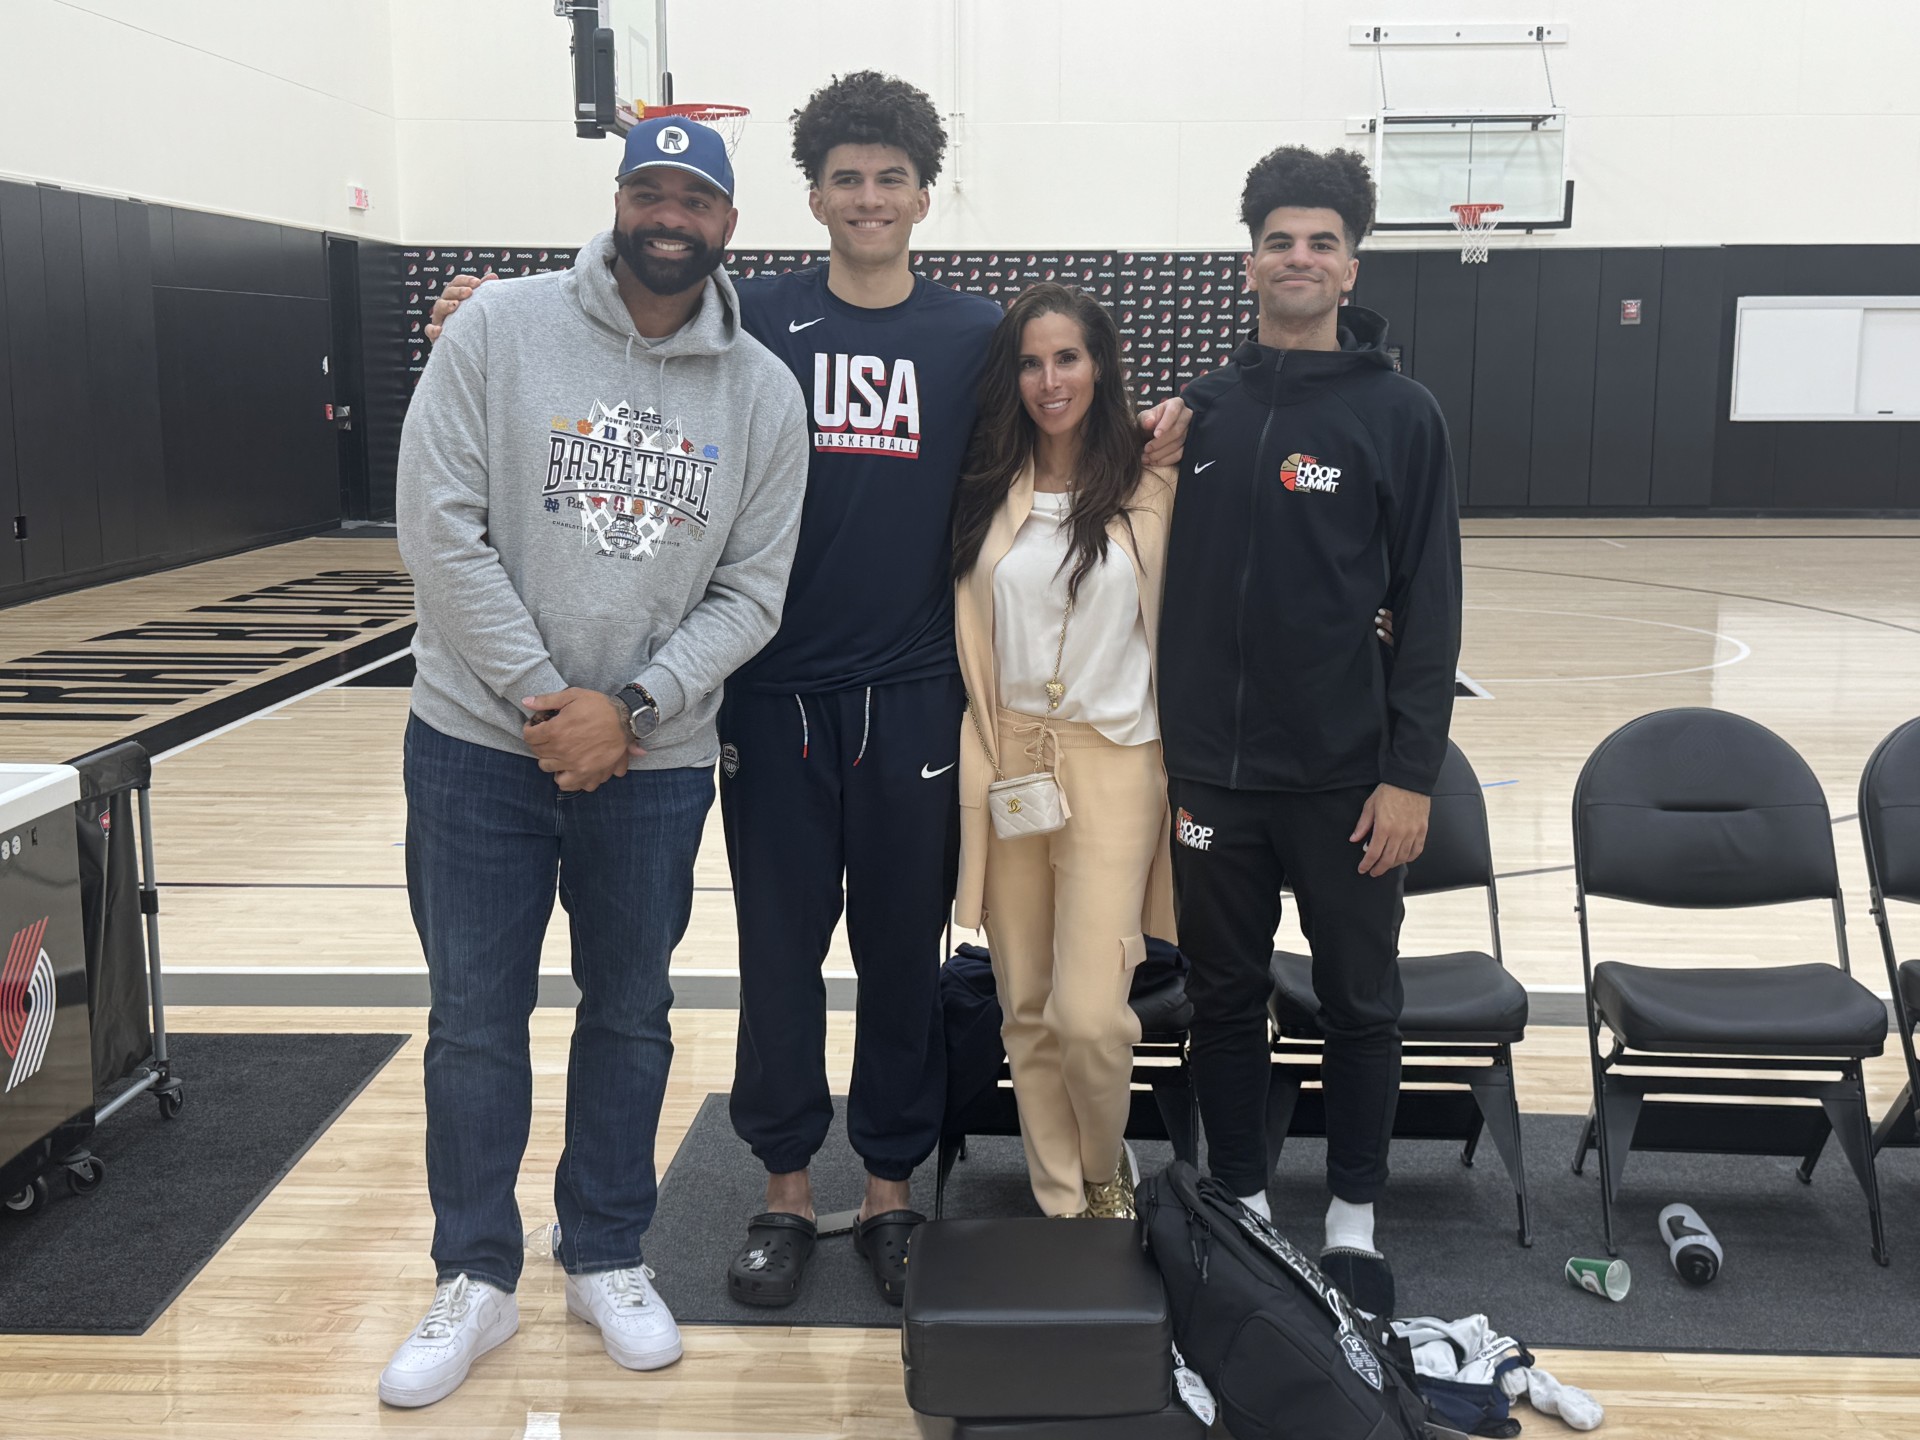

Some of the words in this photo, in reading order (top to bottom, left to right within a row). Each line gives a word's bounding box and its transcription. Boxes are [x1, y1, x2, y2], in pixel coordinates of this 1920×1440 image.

[663, 130, 682, 150] R
[814, 353, 920, 440] USA
[817, 433, 914, 452] BASKETBALL
[543, 436, 713, 523] BASKETBALL
[1297, 462, 1341, 482] HOOP
[583, 482, 674, 503] TOURNMENT
[1295, 475, 1339, 493] SUMMIT
[1180, 817, 1214, 841] HOOP
